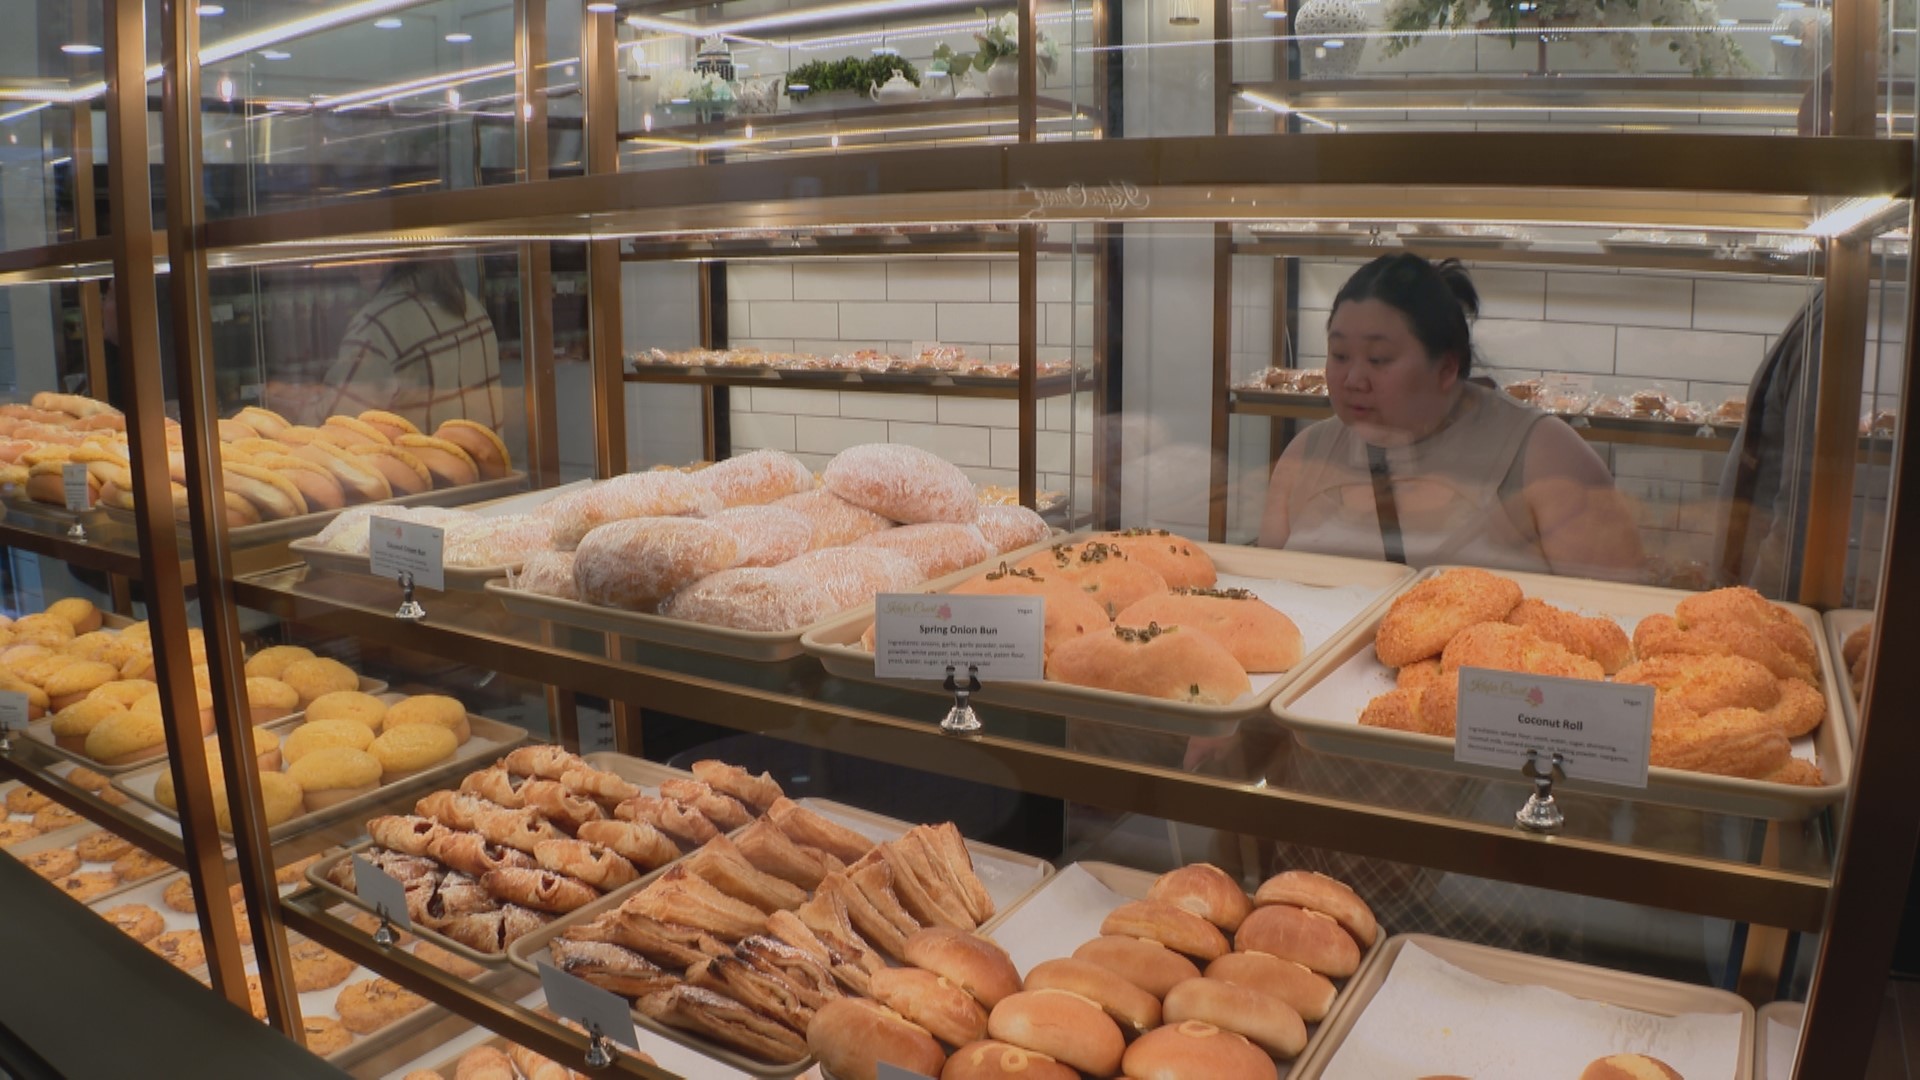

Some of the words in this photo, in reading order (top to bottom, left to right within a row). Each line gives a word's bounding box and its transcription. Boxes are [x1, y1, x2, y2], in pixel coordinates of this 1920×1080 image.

[919, 624, 948, 636] Spring
[950, 625, 978, 635] Onion
[980, 625, 998, 635] Bun
[1517, 713, 1561, 728] Coconut
[1563, 720, 1583, 731] Roll
